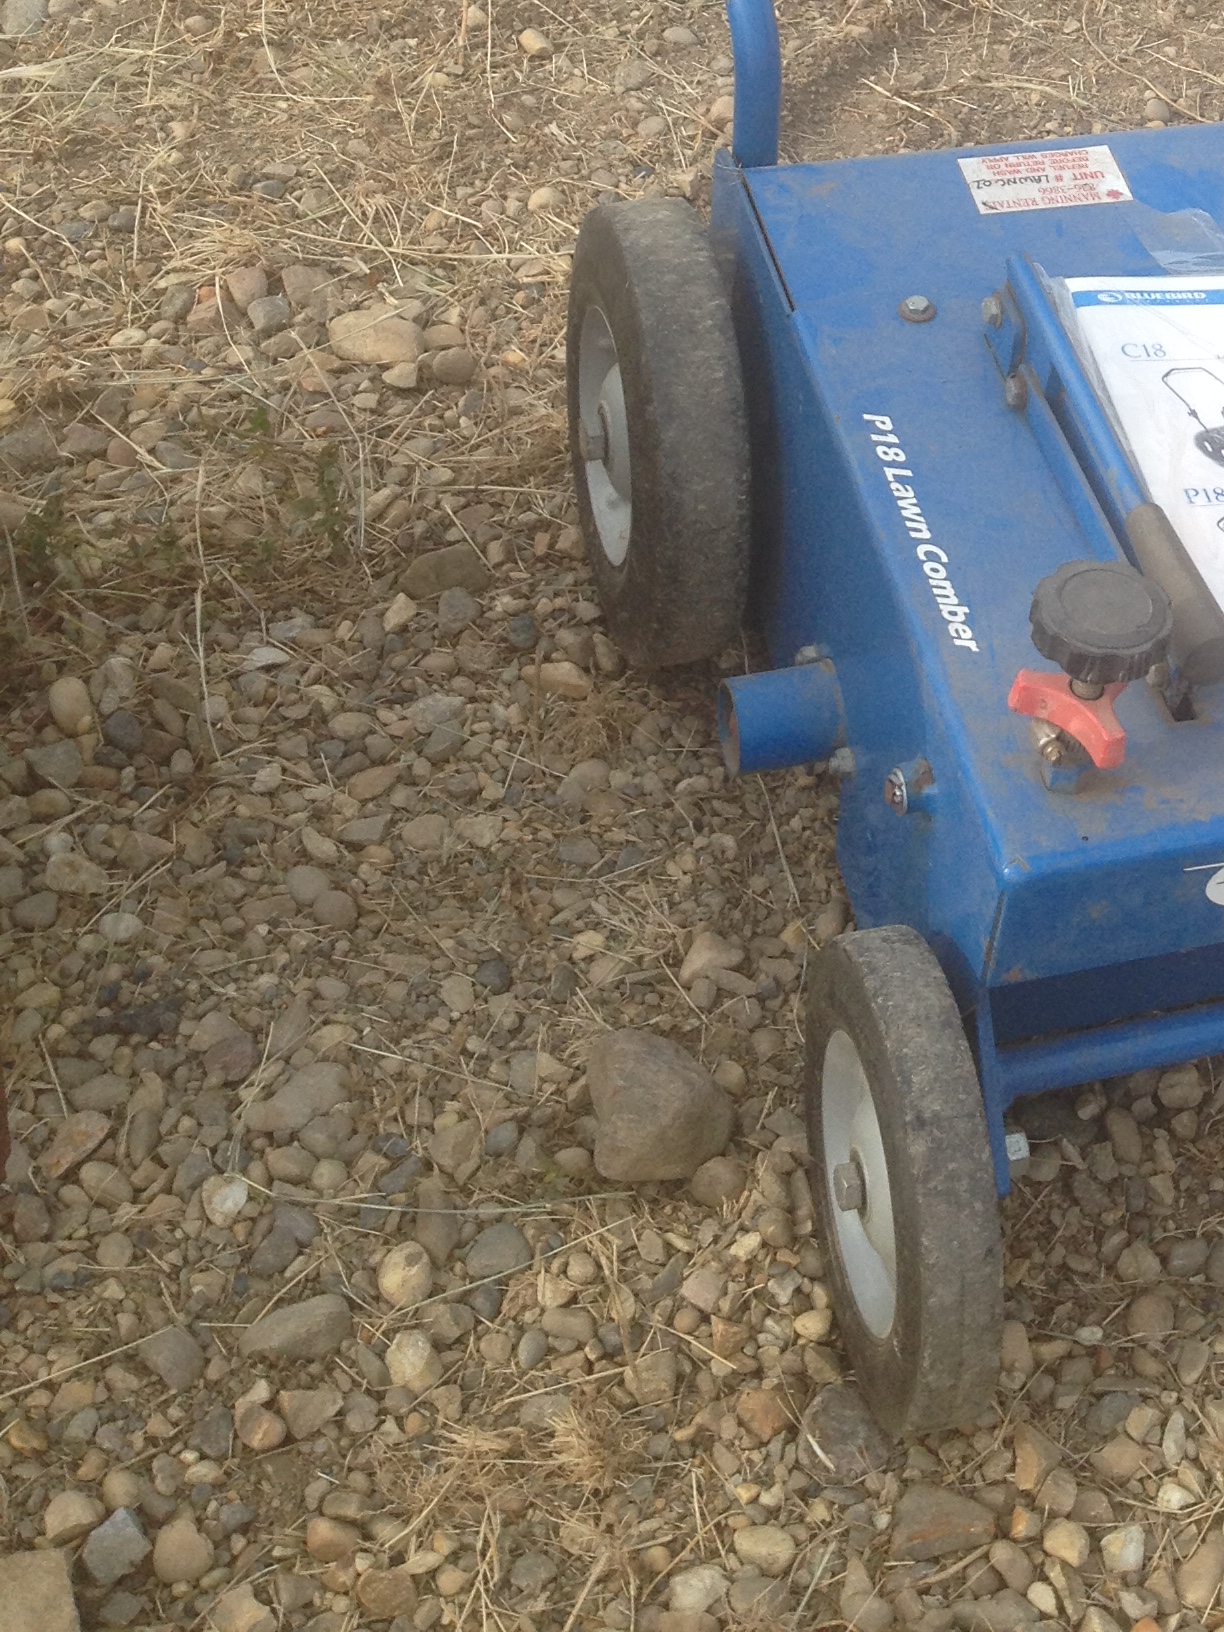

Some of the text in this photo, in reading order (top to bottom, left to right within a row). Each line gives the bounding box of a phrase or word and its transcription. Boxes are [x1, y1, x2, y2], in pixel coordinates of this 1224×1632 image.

[1072, 171, 1104, 181] UNIT
[1121, 343, 1166, 358] C18
[863, 414, 980, 653] P18 Lawn Comber
